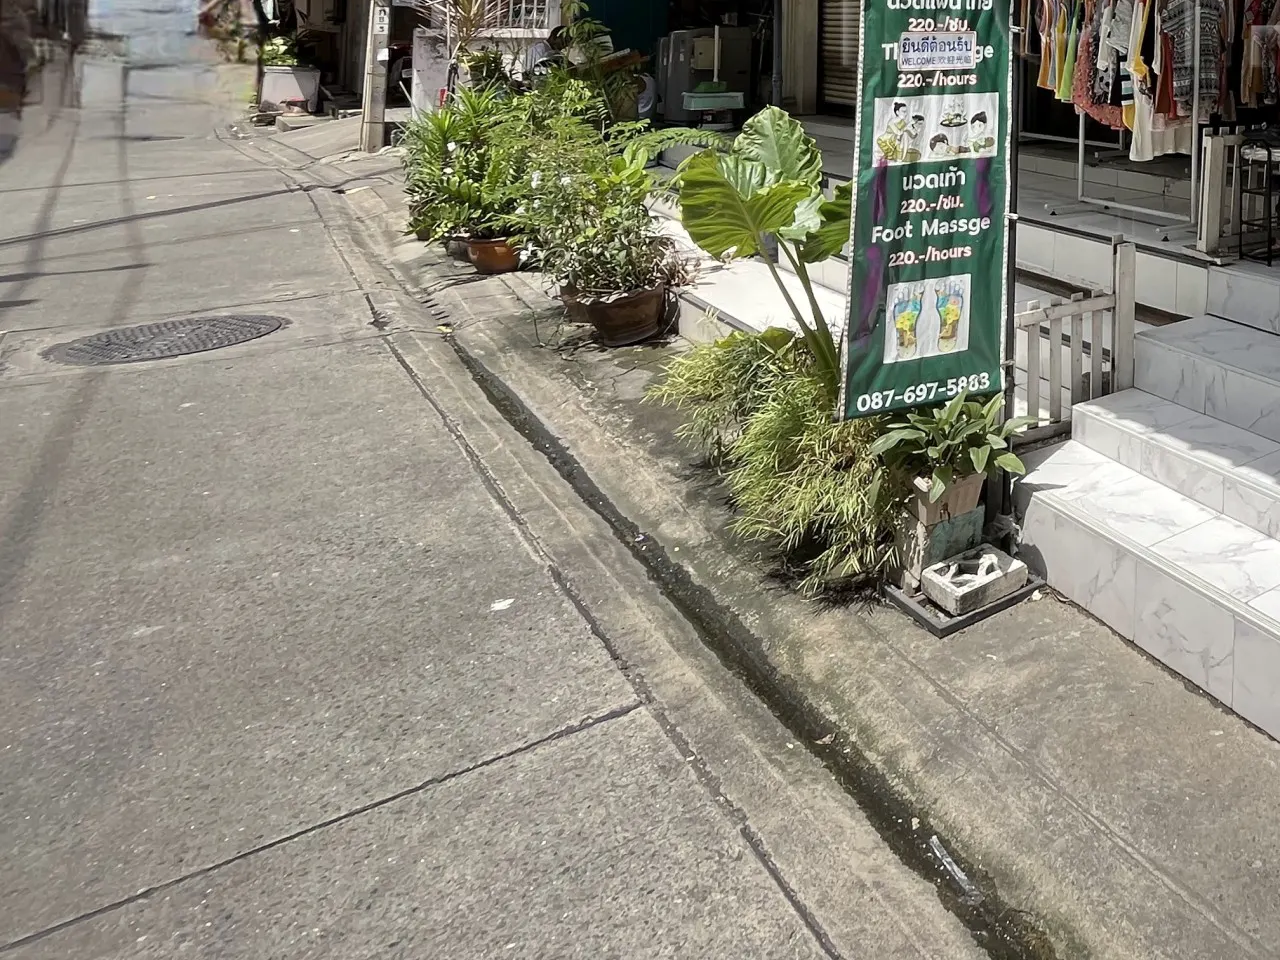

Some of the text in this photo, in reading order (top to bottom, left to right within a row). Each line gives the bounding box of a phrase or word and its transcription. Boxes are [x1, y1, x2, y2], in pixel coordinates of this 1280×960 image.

[901, 55, 936, 66] WELCOME
[871, 216, 992, 244] Foot Massge
[856, 371, 991, 412] 087-697-5883
